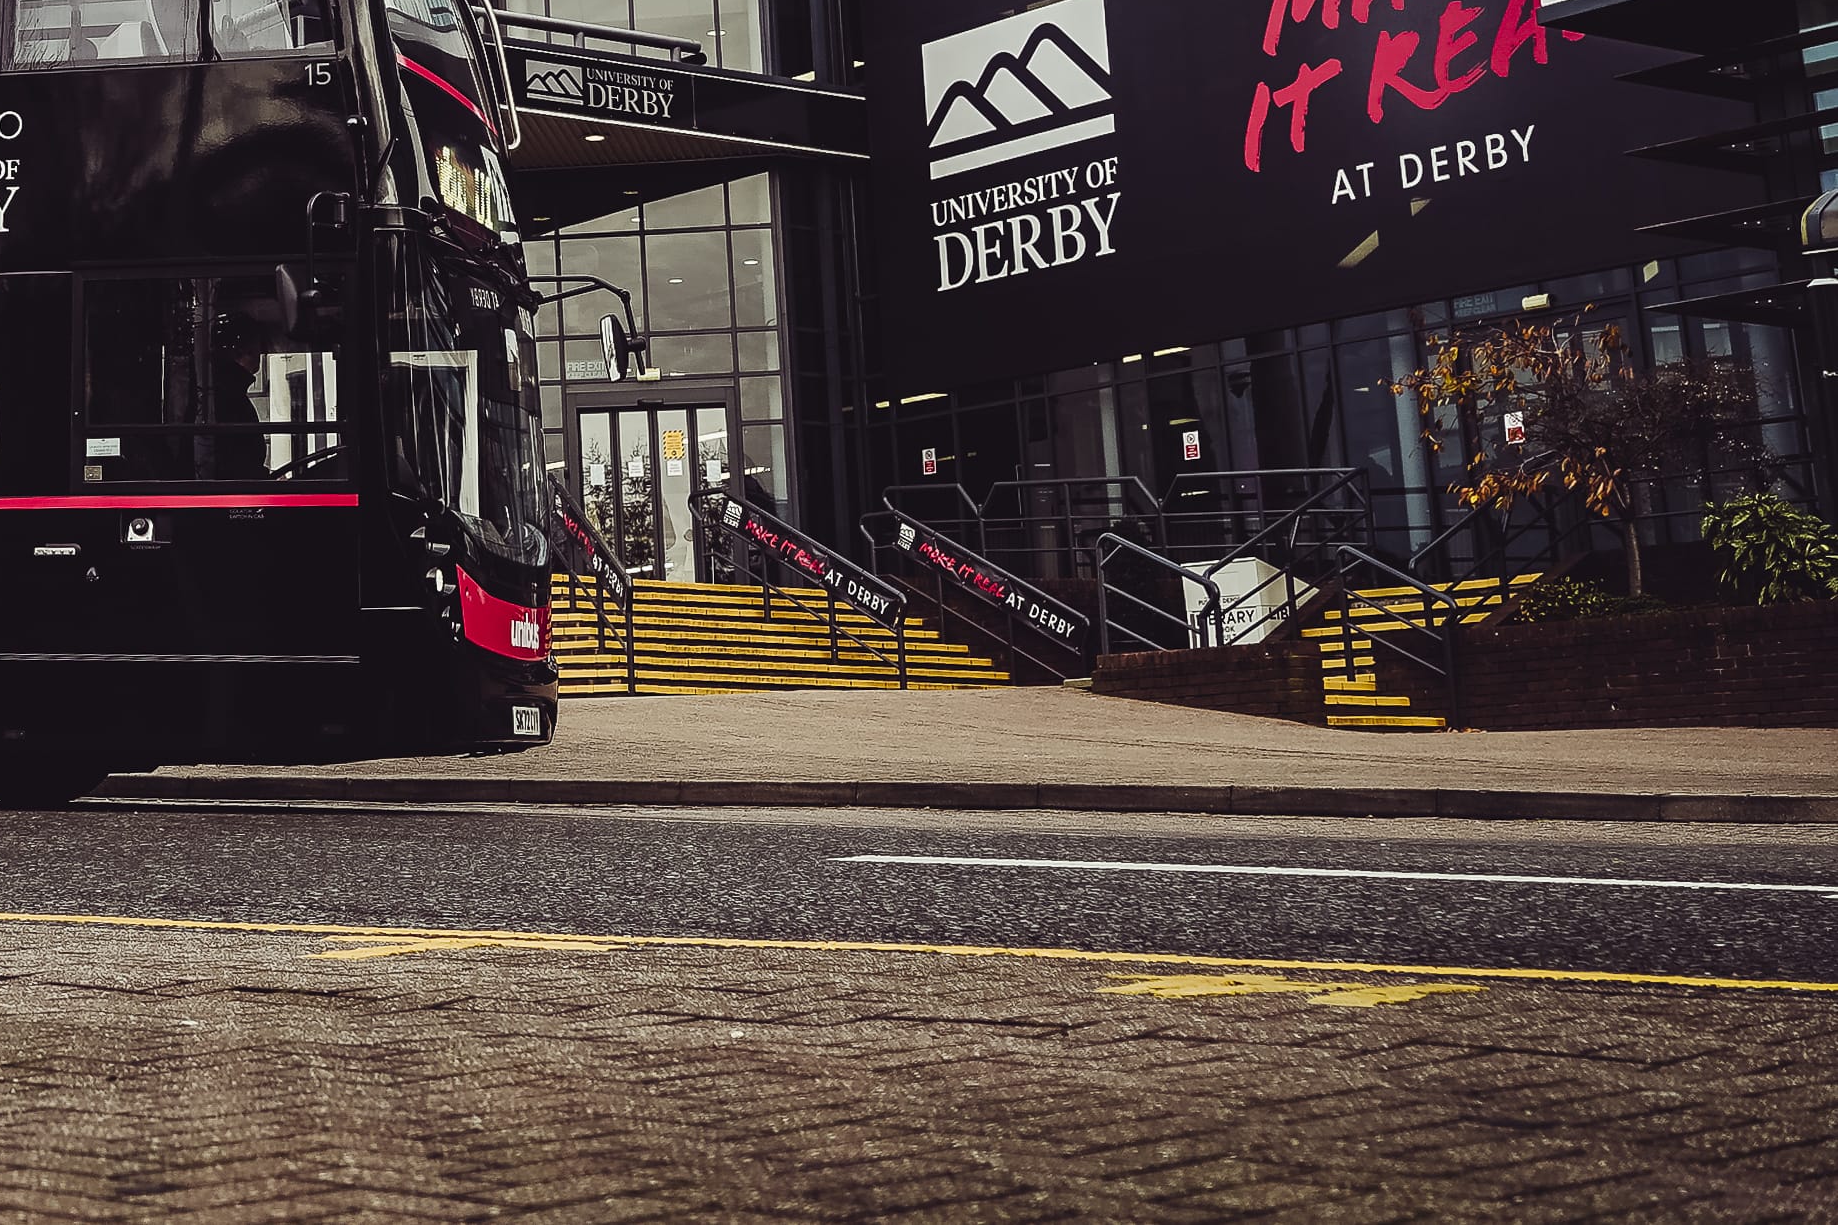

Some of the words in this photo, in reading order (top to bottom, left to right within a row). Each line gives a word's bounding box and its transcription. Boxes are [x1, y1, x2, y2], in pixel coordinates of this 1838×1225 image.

[304, 62, 332, 86] 15
[586, 67, 658, 89] UNIVERSITY
[659, 78, 674, 91] OF
[587, 82, 674, 118] DERBY
[1244, 59, 1343, 172] IT
[930, 167, 1079, 226] UNIVERSITY
[1086, 157, 1119, 189] OF
[1331, 162, 1374, 205] AT
[1399, 124, 1535, 189] DERBY
[933, 191, 1122, 292] DERBY
[566, 361, 586, 371] FIRE
[780, 540, 797, 556] IT
[824, 569, 844, 588] AT
[847, 580, 890, 615] DERBY
[1005, 592, 1026, 611] AT
[1029, 604, 1075, 638] DERBY
